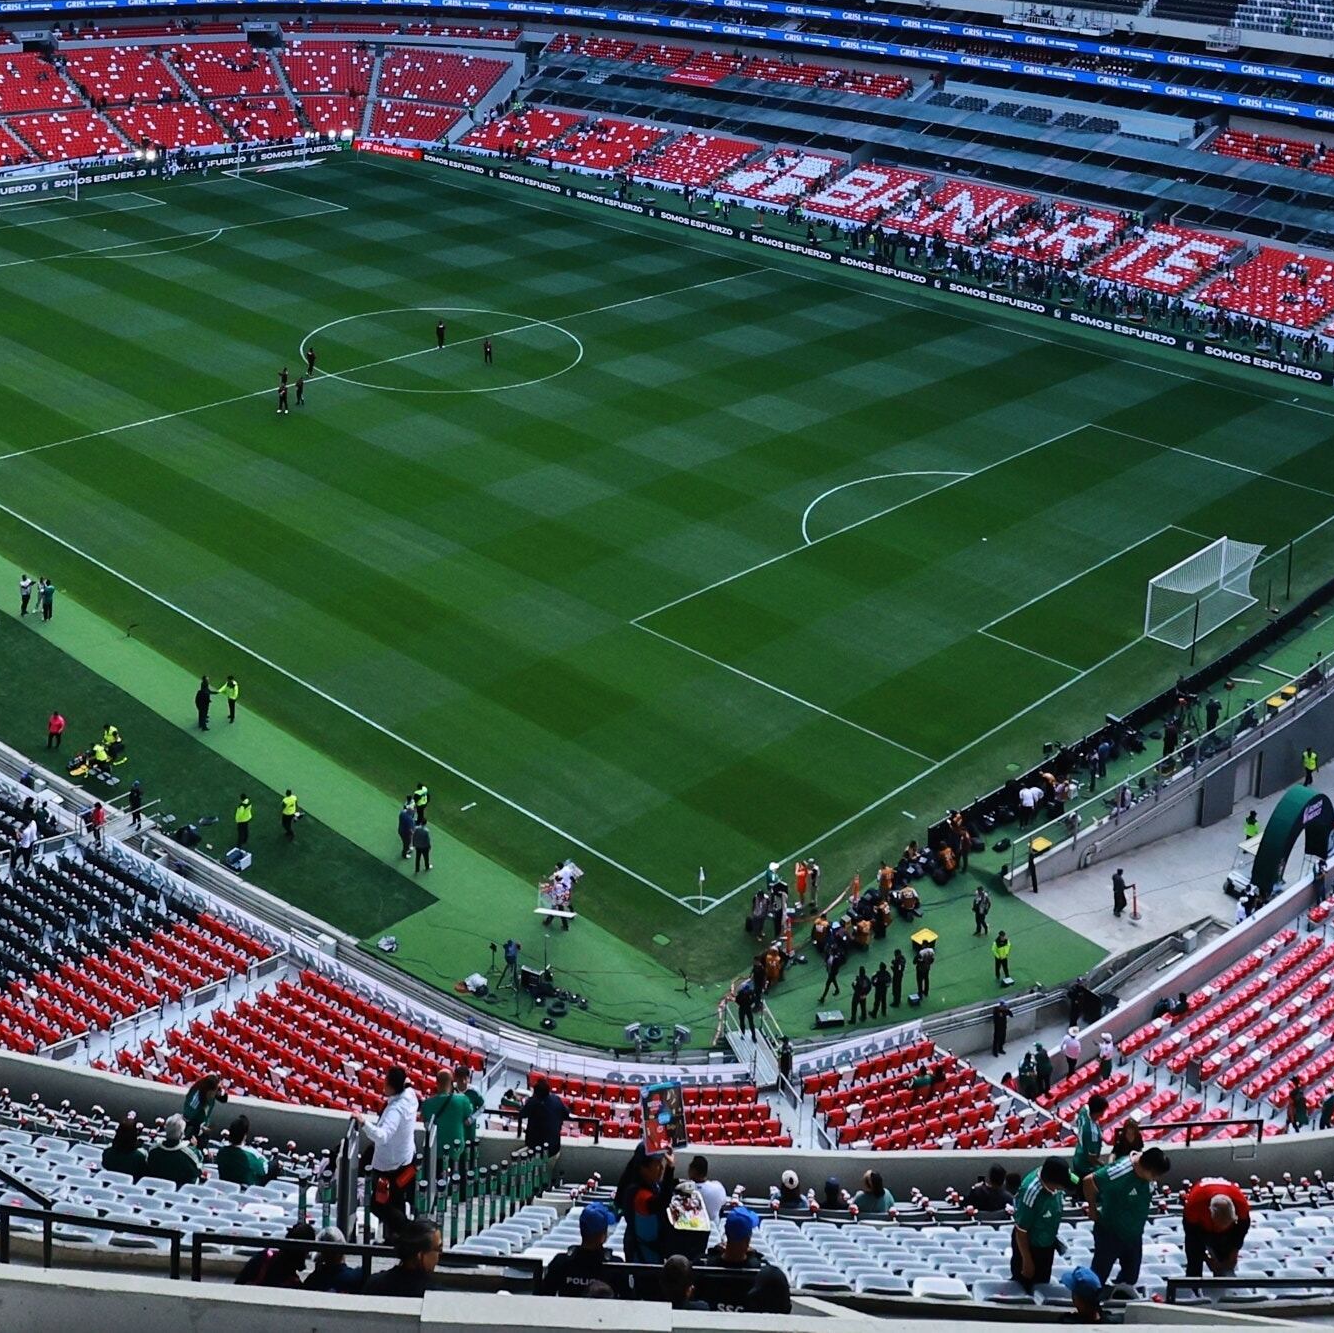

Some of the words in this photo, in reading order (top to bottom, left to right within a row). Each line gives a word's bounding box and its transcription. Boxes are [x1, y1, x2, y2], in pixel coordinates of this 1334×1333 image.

[1240, 65, 1265, 76] GRISI
[1238, 97, 1262, 109] GRISI
[260, 149, 293, 160] SOMOS
[294, 144, 337, 156] ESFUERZO
[373, 145, 415, 158] BANORTE
[424, 154, 447, 166] SOMOS
[448, 159, 485, 175] ESFUERZO
[499, 171, 524, 184] SOMOS
[525, 178, 561, 194] ESFUERZO
[576, 191, 604, 204] SOMOS
[604, 198, 643, 214] ESFUERZO
[660, 211, 690, 226] SOMOS
[690, 219, 733, 236] ESFUERZO
[751, 234, 784, 250] SOMOS
[784, 242, 832, 261] ESFUERZO
[839, 256, 875, 272] SOMOS
[875, 264, 927, 285] ESFUERZO
[949, 282, 988, 300] SOMOS
[988, 293, 1046, 314] ESFUERZO
[1070, 312, 1113, 332] SOMOS
[1113, 322, 1177, 346] ESFUERZO
[1204, 345, 1251, 365] SOMOS
[1252, 356, 1323, 382] ESFUERZO
